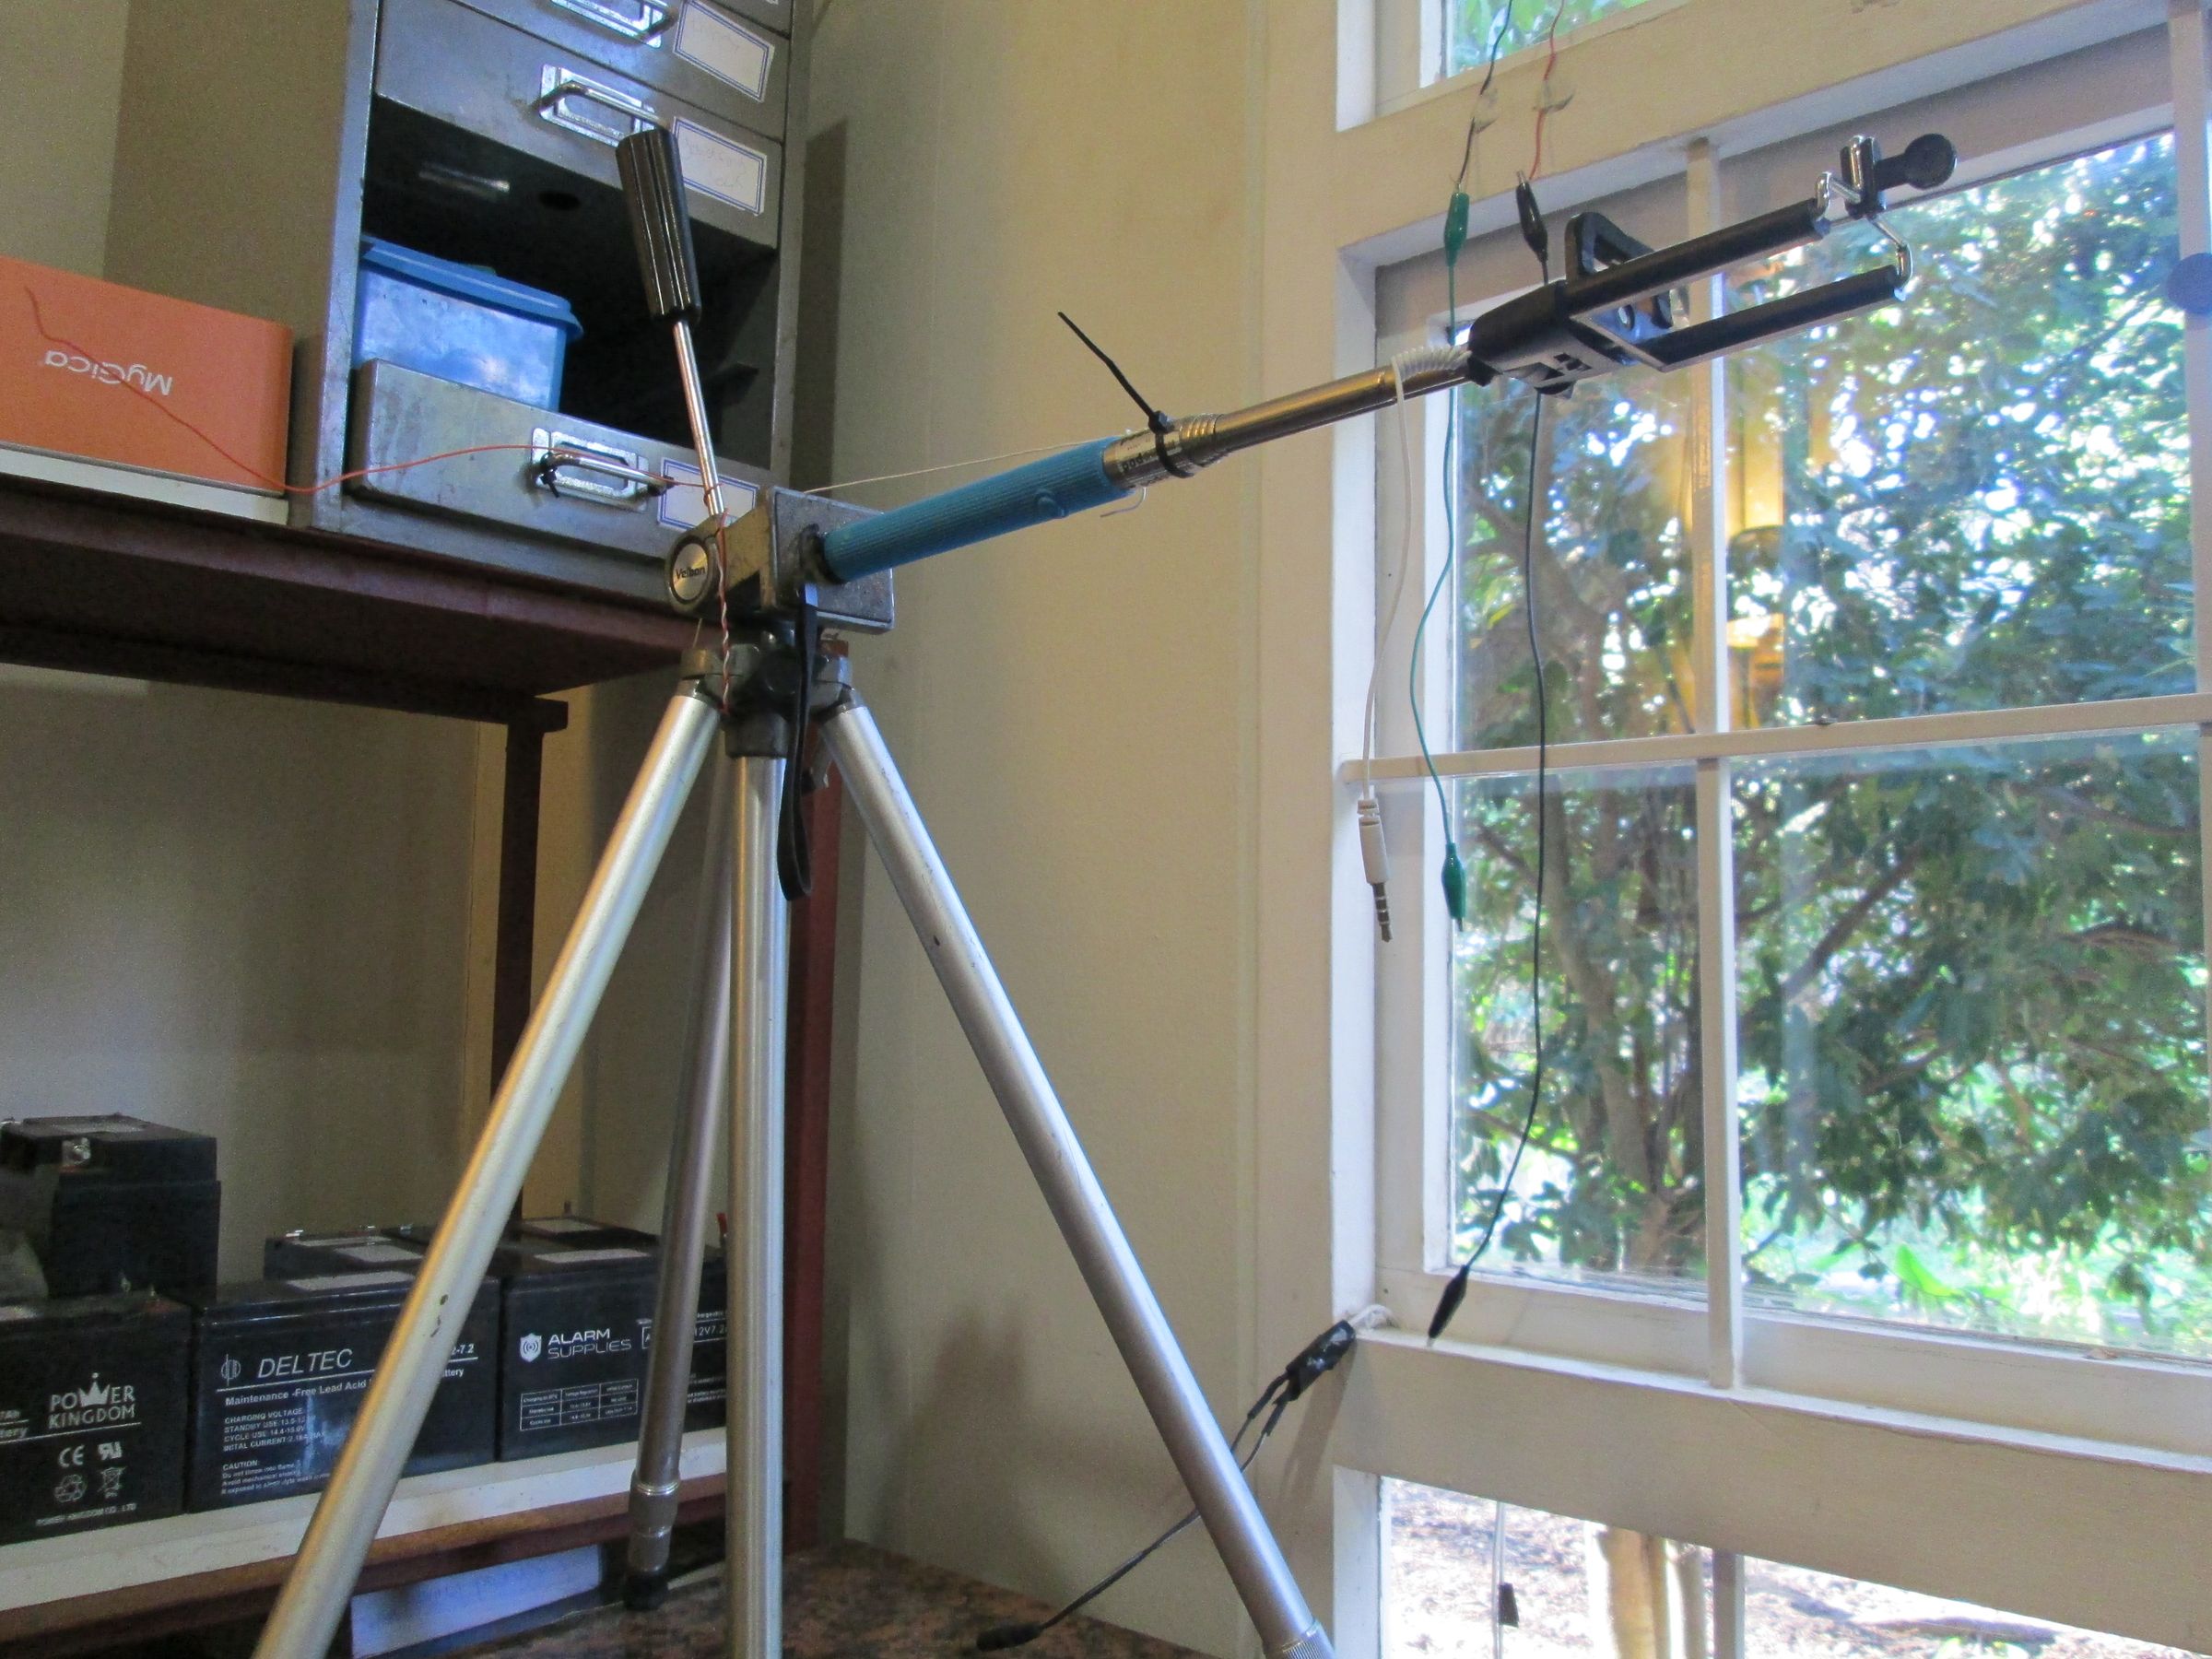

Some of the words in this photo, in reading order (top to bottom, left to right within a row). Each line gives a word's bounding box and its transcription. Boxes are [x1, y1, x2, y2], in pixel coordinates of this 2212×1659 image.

[45, 350, 172, 395] MyGica
[547, 1339, 632, 1359] SUPPLIES
[548, 1328, 610, 1346] ALARM
[258, 1348, 353, 1379] DELTEC
[51, 1382, 135, 1412] POWER
[225, 1392, 289, 1407] Maintenance
[319, 1384, 343, 1394] Lead
[345, 1380, 367, 1390] Acid
[48, 1404, 136, 1429] KINGDOM
[224, 1413, 266, 1424] CHARGING
